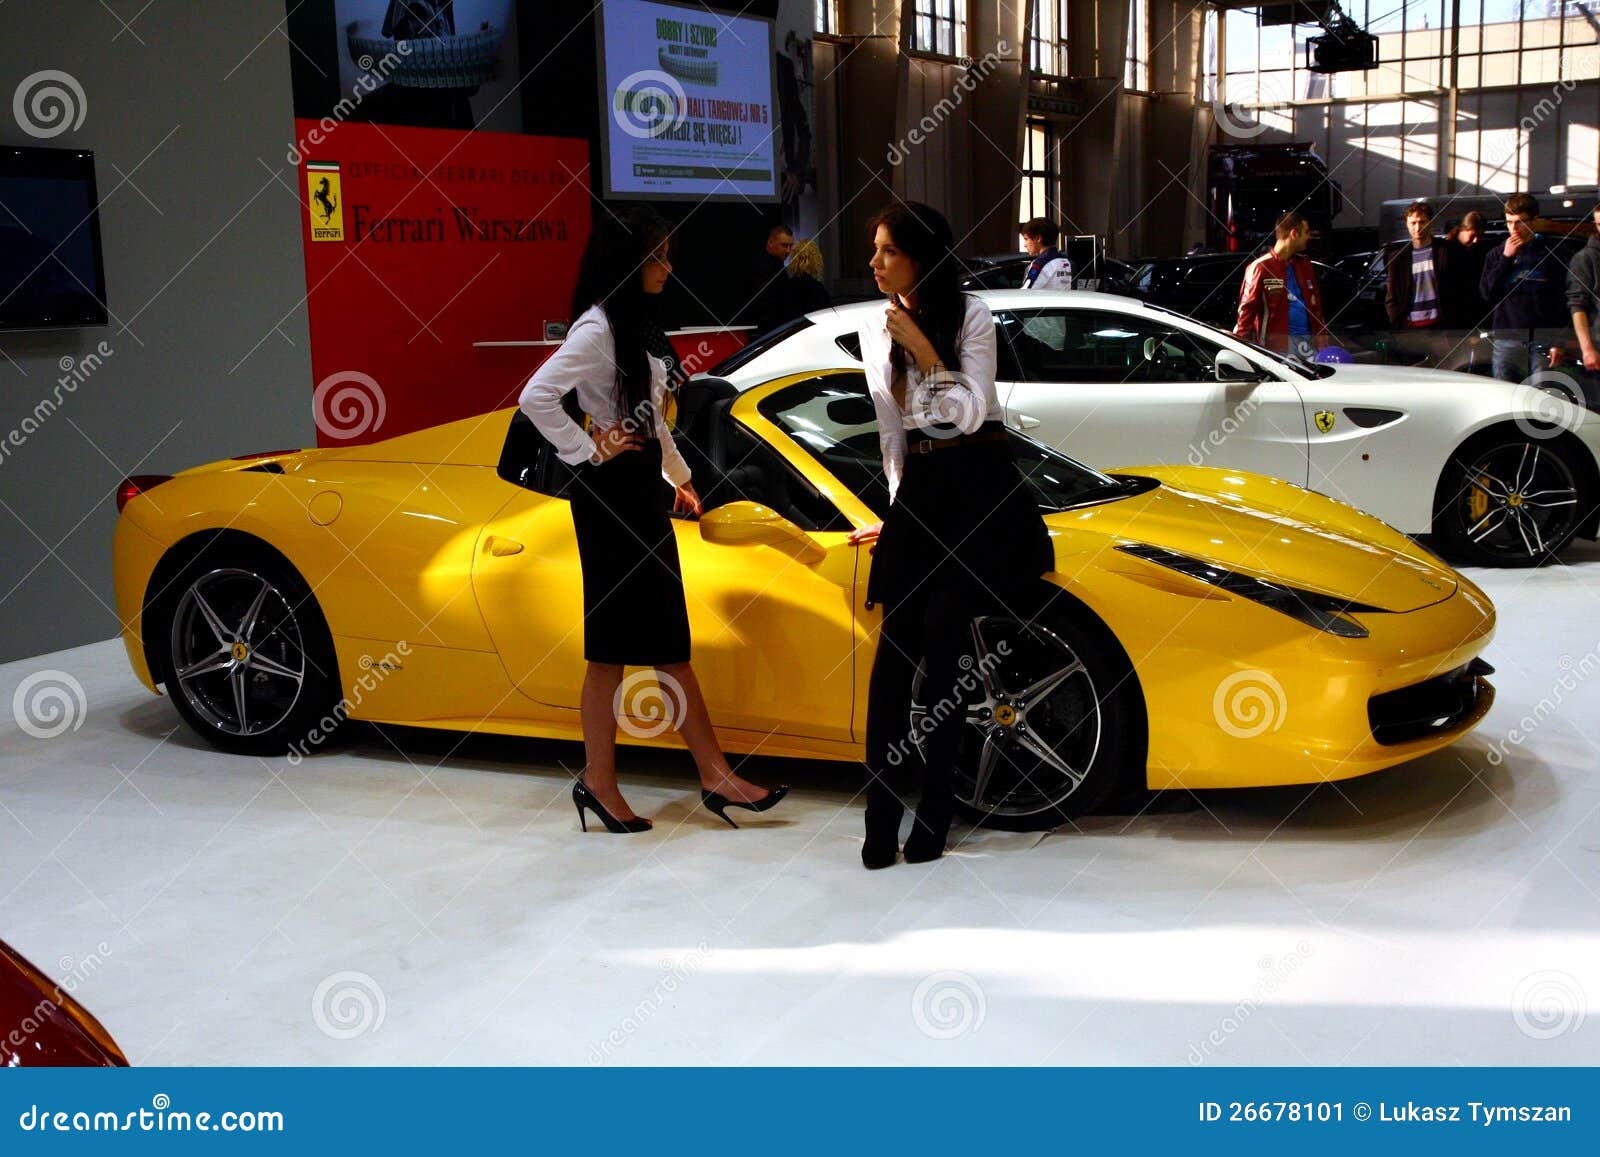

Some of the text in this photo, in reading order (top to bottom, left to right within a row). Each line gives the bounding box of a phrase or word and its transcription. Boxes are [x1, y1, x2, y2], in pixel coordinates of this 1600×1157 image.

[656, 18, 682, 43] DOBRY
[687, 97, 705, 118] HALI
[707, 99, 748, 122] TARGOWEJ
[750, 104, 761, 123] NR
[762, 105, 768, 124] 5
[694, 122, 706, 146] SIĘ
[709, 123, 737, 147] WIĘCEJ
[314, 228, 341, 238] Ferrari
[352, 205, 567, 243] Ferrari Warszawa
